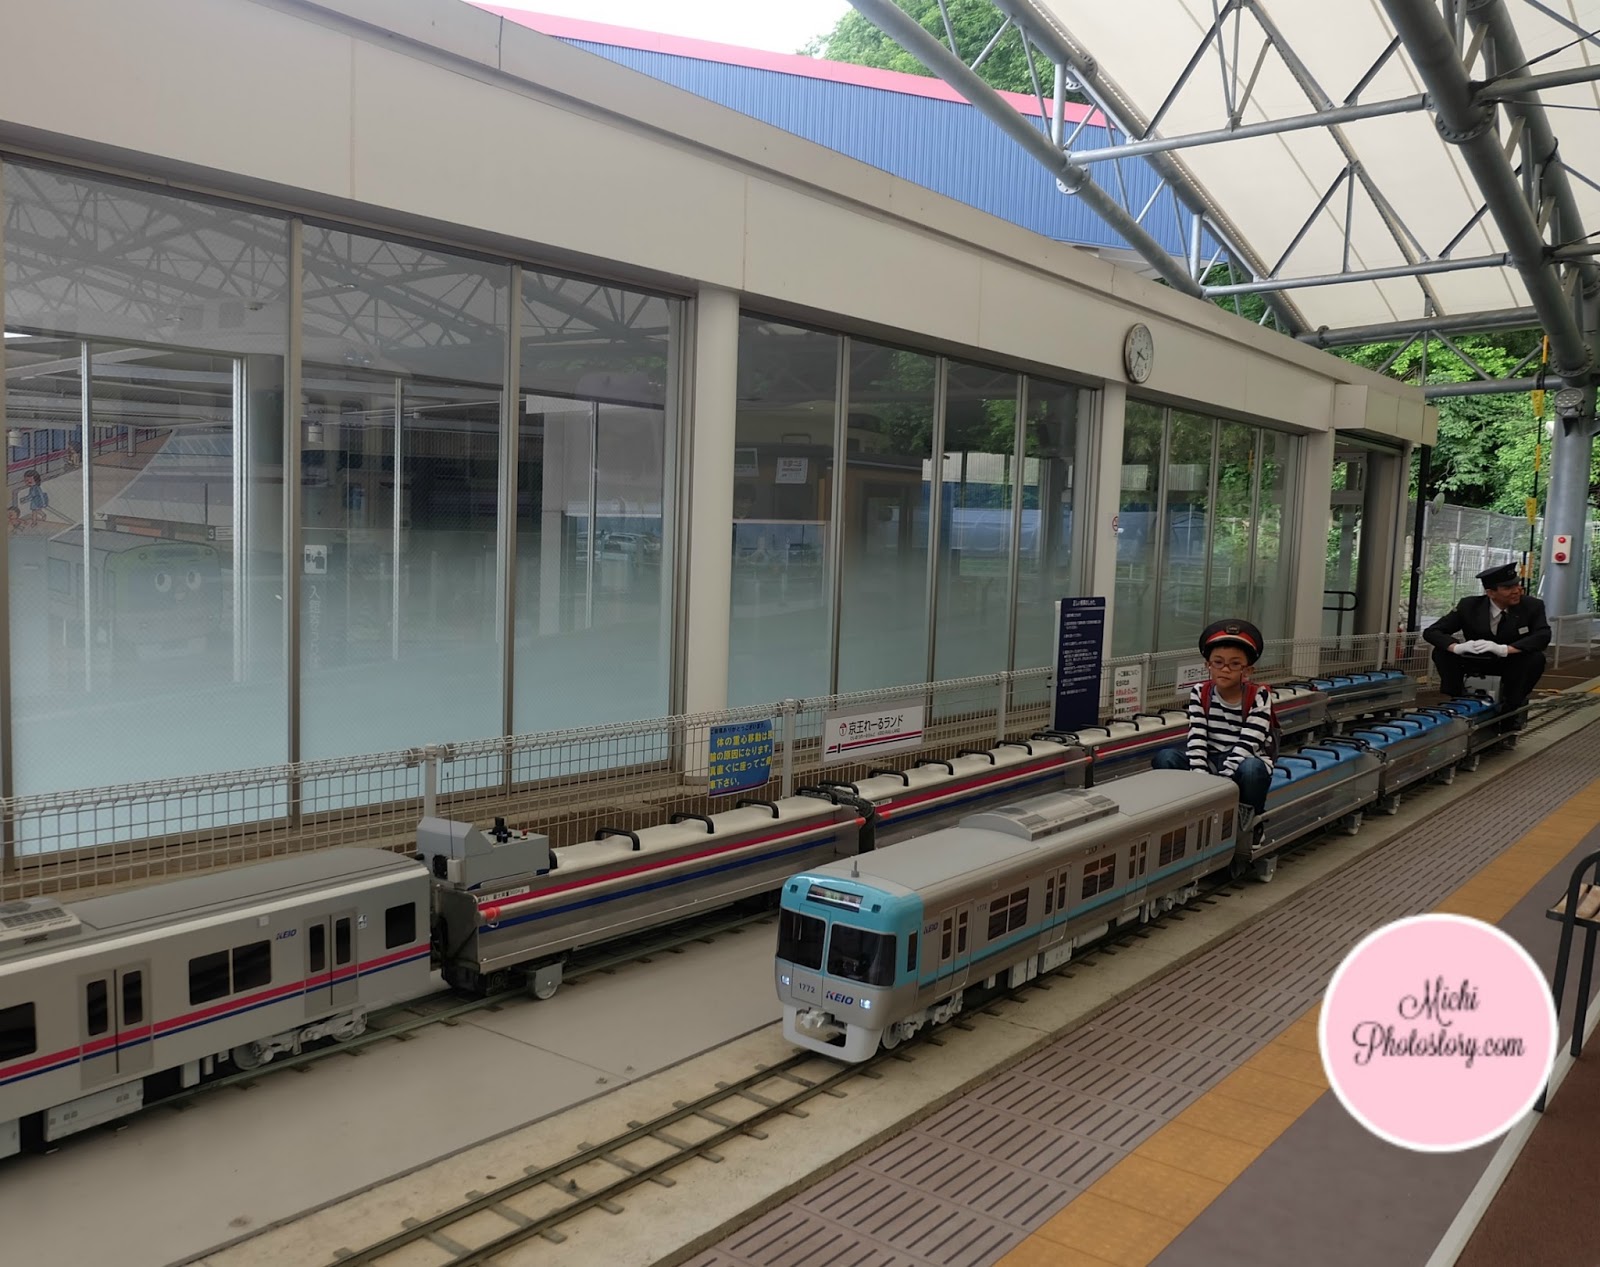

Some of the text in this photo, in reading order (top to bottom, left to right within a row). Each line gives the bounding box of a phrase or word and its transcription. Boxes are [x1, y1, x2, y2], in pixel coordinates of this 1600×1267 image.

[848, 715, 904, 736] 京王れーるランド
[276, 929, 297, 940] KEIO
[799, 983, 815, 994] 1772
[825, 990, 854, 1005] KEIO
